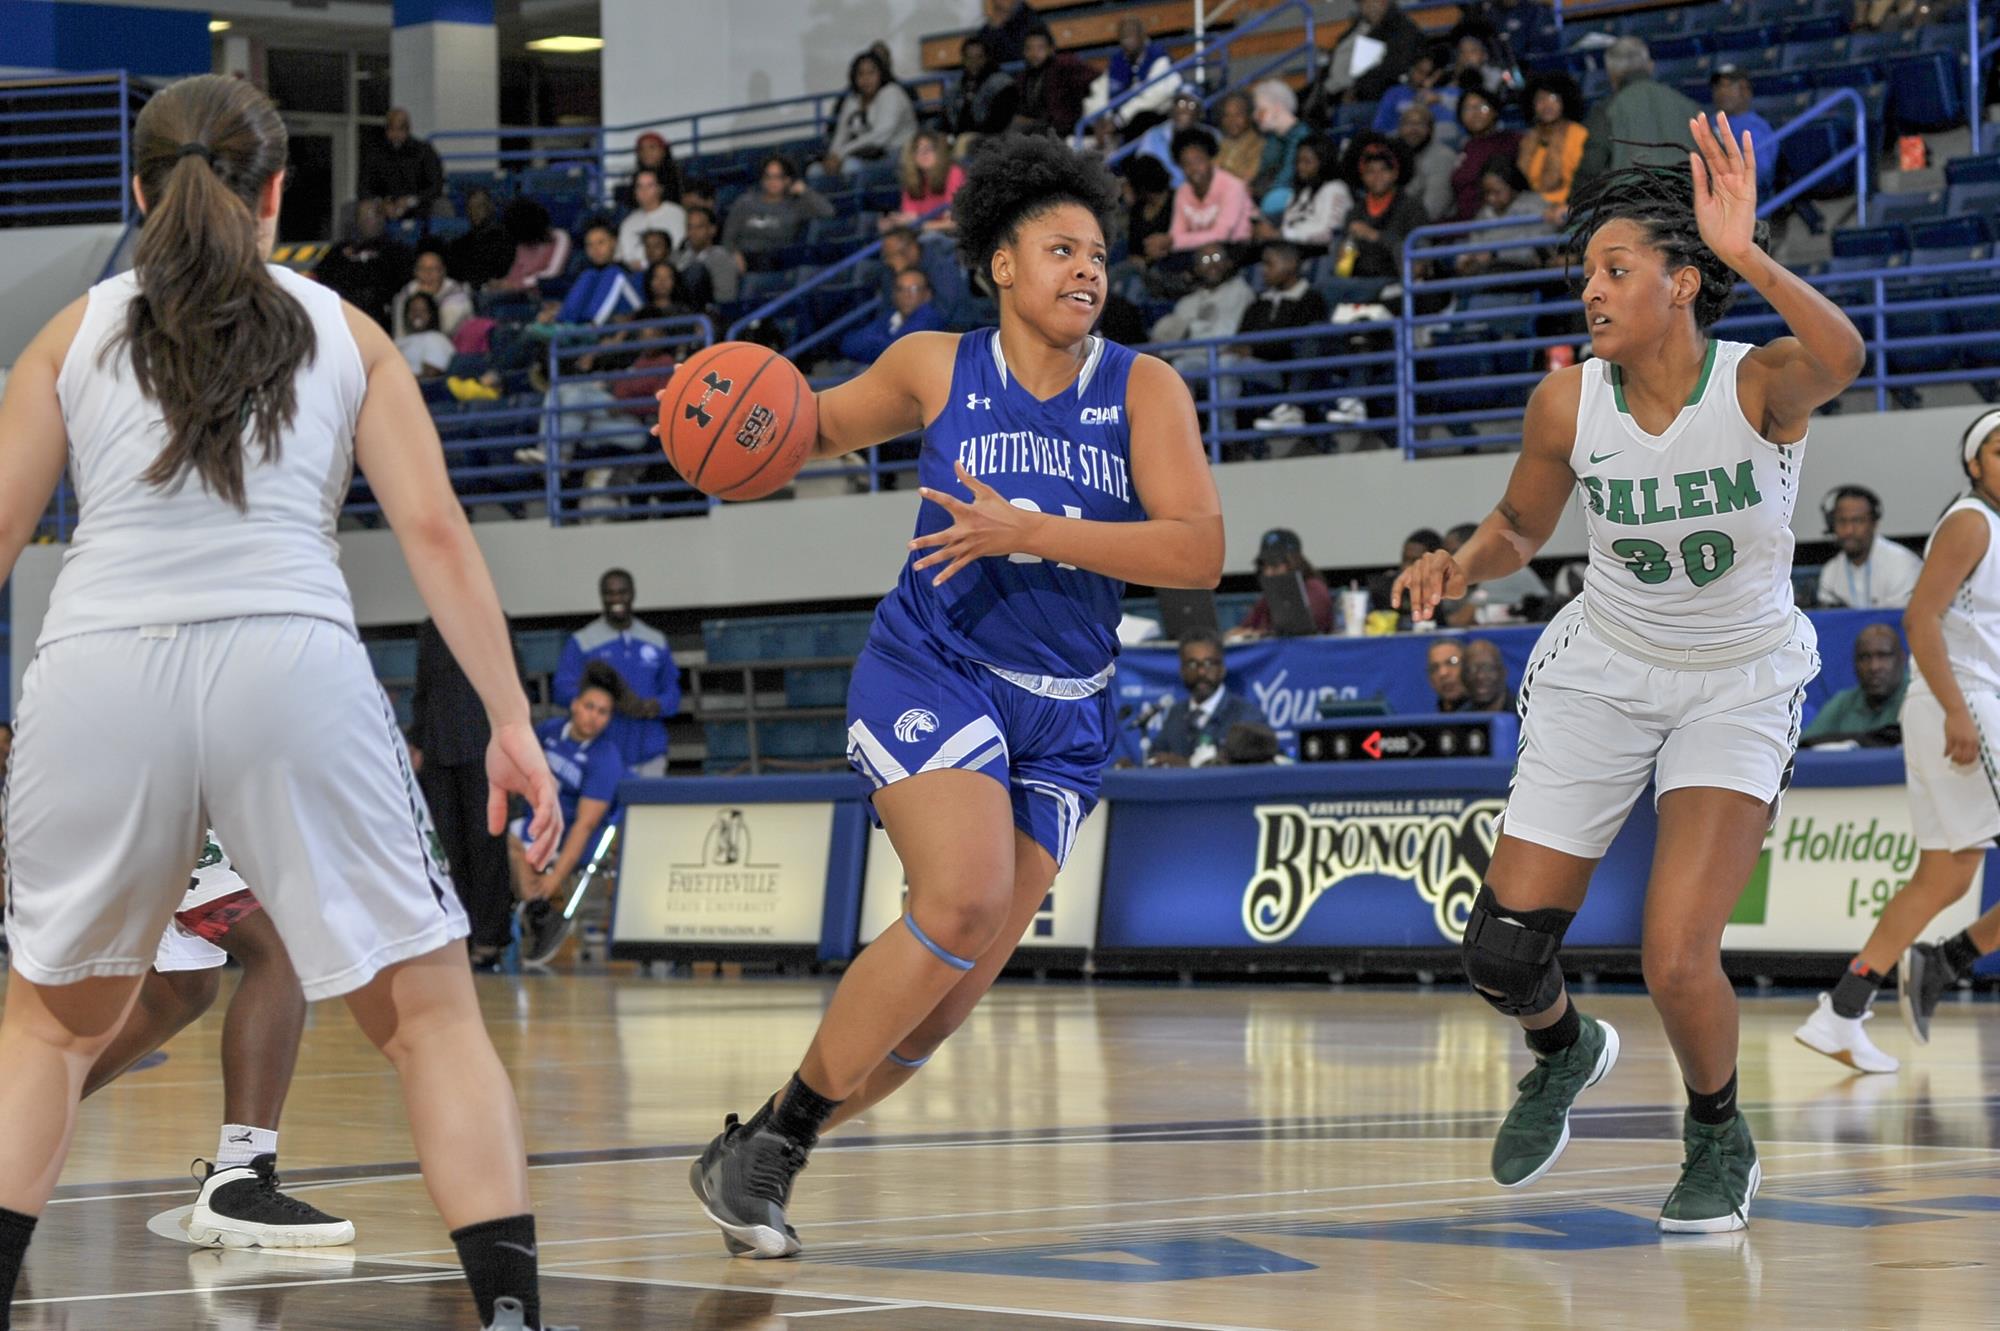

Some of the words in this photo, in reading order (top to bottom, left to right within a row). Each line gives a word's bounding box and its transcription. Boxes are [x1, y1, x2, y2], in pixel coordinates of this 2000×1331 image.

[736, 403, 772, 449] 695
[957, 431, 1074, 482] FAYETTEVILLE
[1079, 443, 1130, 503] STATE
[1584, 459, 1762, 525] SALEM
[1612, 530, 1737, 587] 30
[1309, 801, 1413, 815] FAYETTEVILLE
[1418, 800, 1463, 813] STATE
[1242, 800, 1507, 943] BRONCOS
[1783, 817, 1917, 872] Holiday
